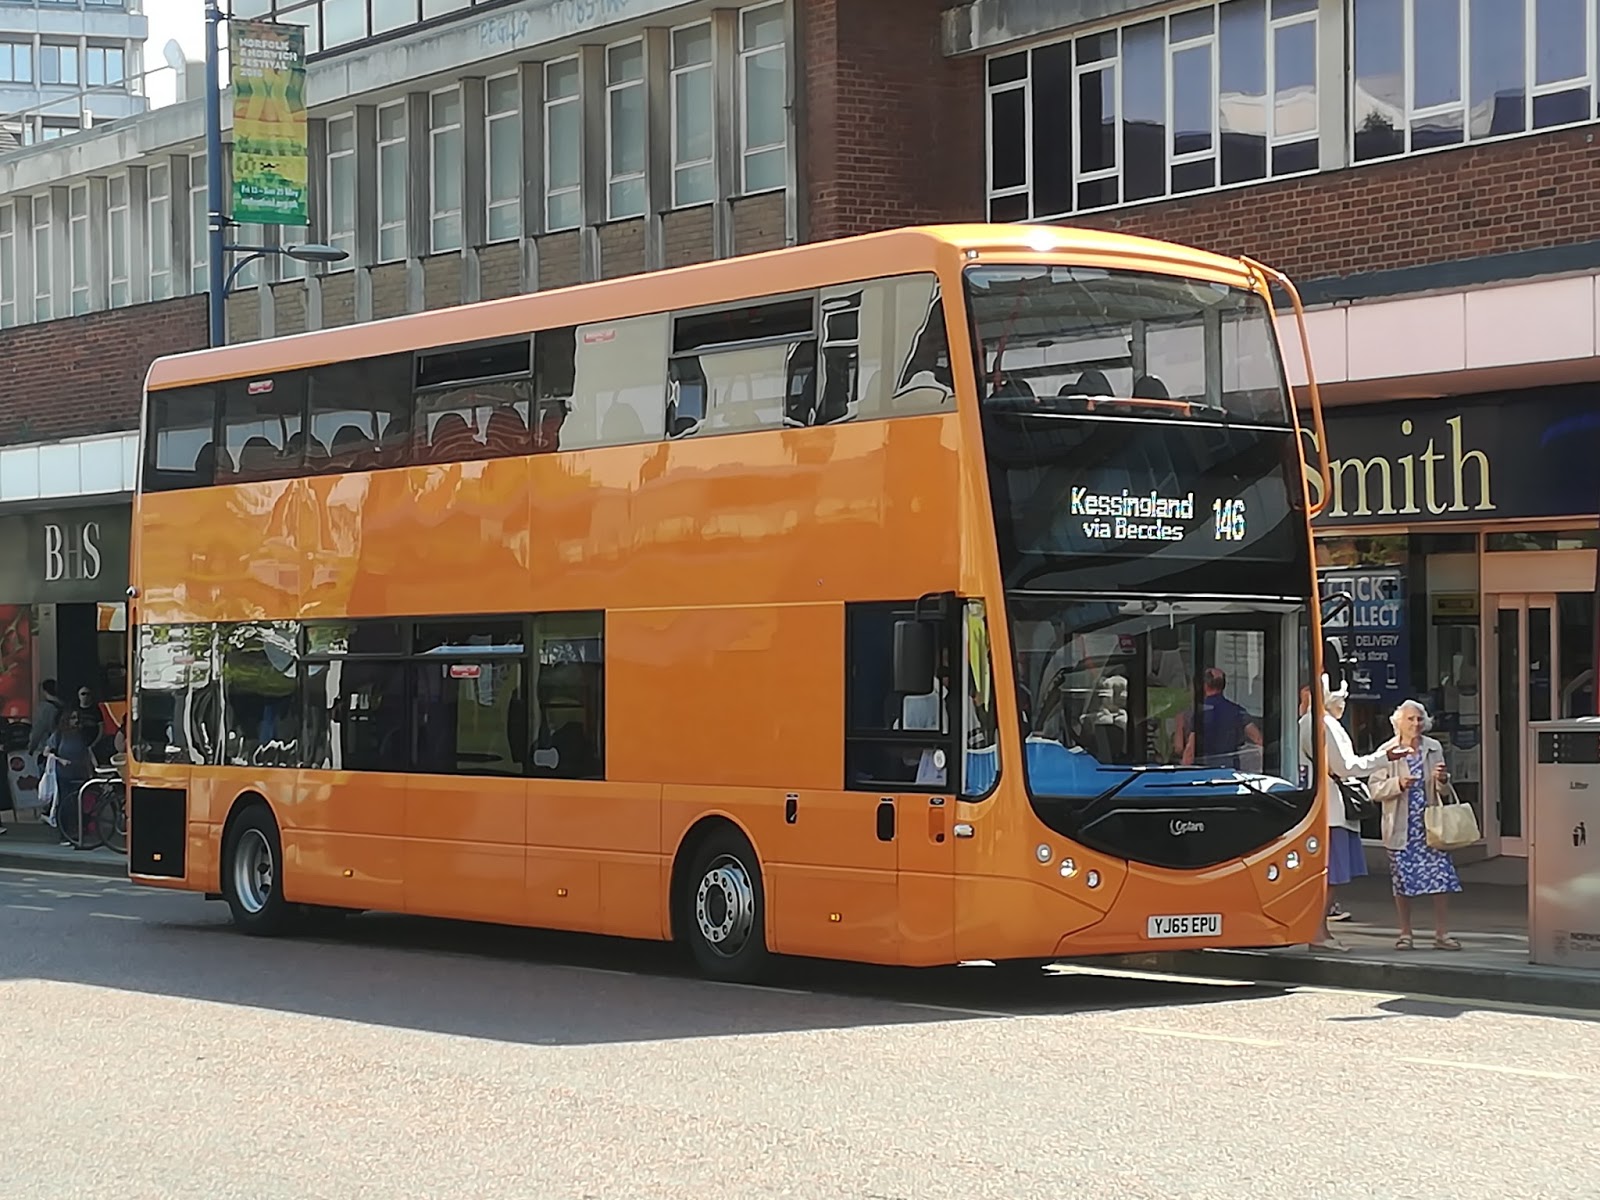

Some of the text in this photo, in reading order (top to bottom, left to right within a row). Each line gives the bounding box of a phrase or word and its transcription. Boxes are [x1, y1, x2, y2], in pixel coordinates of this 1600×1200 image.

[239, 38, 289, 50] NORFOLK
[240, 58, 288, 70] FESTIVAL
[1299, 415, 1497, 519] Smith
[1070, 486, 1194, 519] Kessingland
[1083, 517, 1184, 541] via Beccles
[1212, 498, 1246, 541] 146
[44, 521, 101, 582] BHS
[1355, 635, 1399, 647] DELIVERY
[1154, 916, 1217, 934] YJ65 EPU
